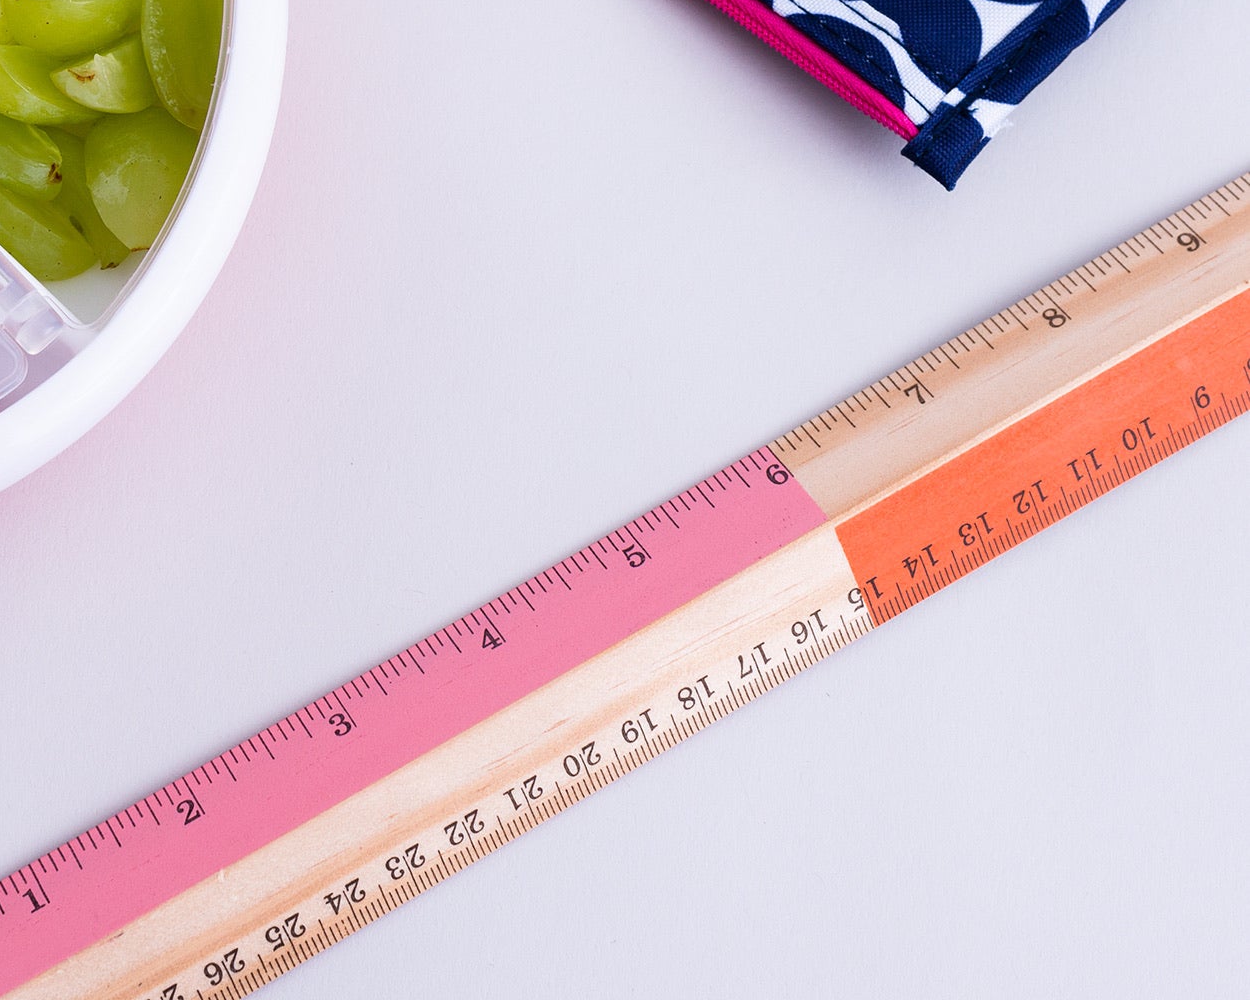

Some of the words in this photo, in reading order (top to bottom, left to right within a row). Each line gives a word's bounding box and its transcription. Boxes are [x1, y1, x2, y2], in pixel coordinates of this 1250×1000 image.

[1121, 416, 1157, 451] 10
[1066, 447, 1103, 482] 11
[1012, 479, 1049, 514] 12
[957, 511, 995, 547] 13
[22, 888, 47, 914] 1
[175, 798, 203, 826] 2
[328, 712, 352, 737] 3
[480, 627, 503, 650] 4
[621, 544, 647, 568] 5
[765, 464, 790, 486] 6
[903, 383, 928, 405] 7
[1041, 307, 1067, 329] 8
[1176, 231, 1201, 253] 9
[902, 543, 940, 579] 14
[847, 576, 884, 613] 15
[790, 608, 828, 645] 16
[737, 641, 772, 679] 17
[677, 674, 716, 710] 18
[620, 708, 659, 744] 19
[563, 740, 602, 777] 20
[503, 774, 544, 812] 21
[444, 808, 486, 846] 22
[384, 842, 426, 881] 23
[323, 878, 367, 916] 24
[264, 912, 307, 952] 25
[203, 947, 246, 987] 26
